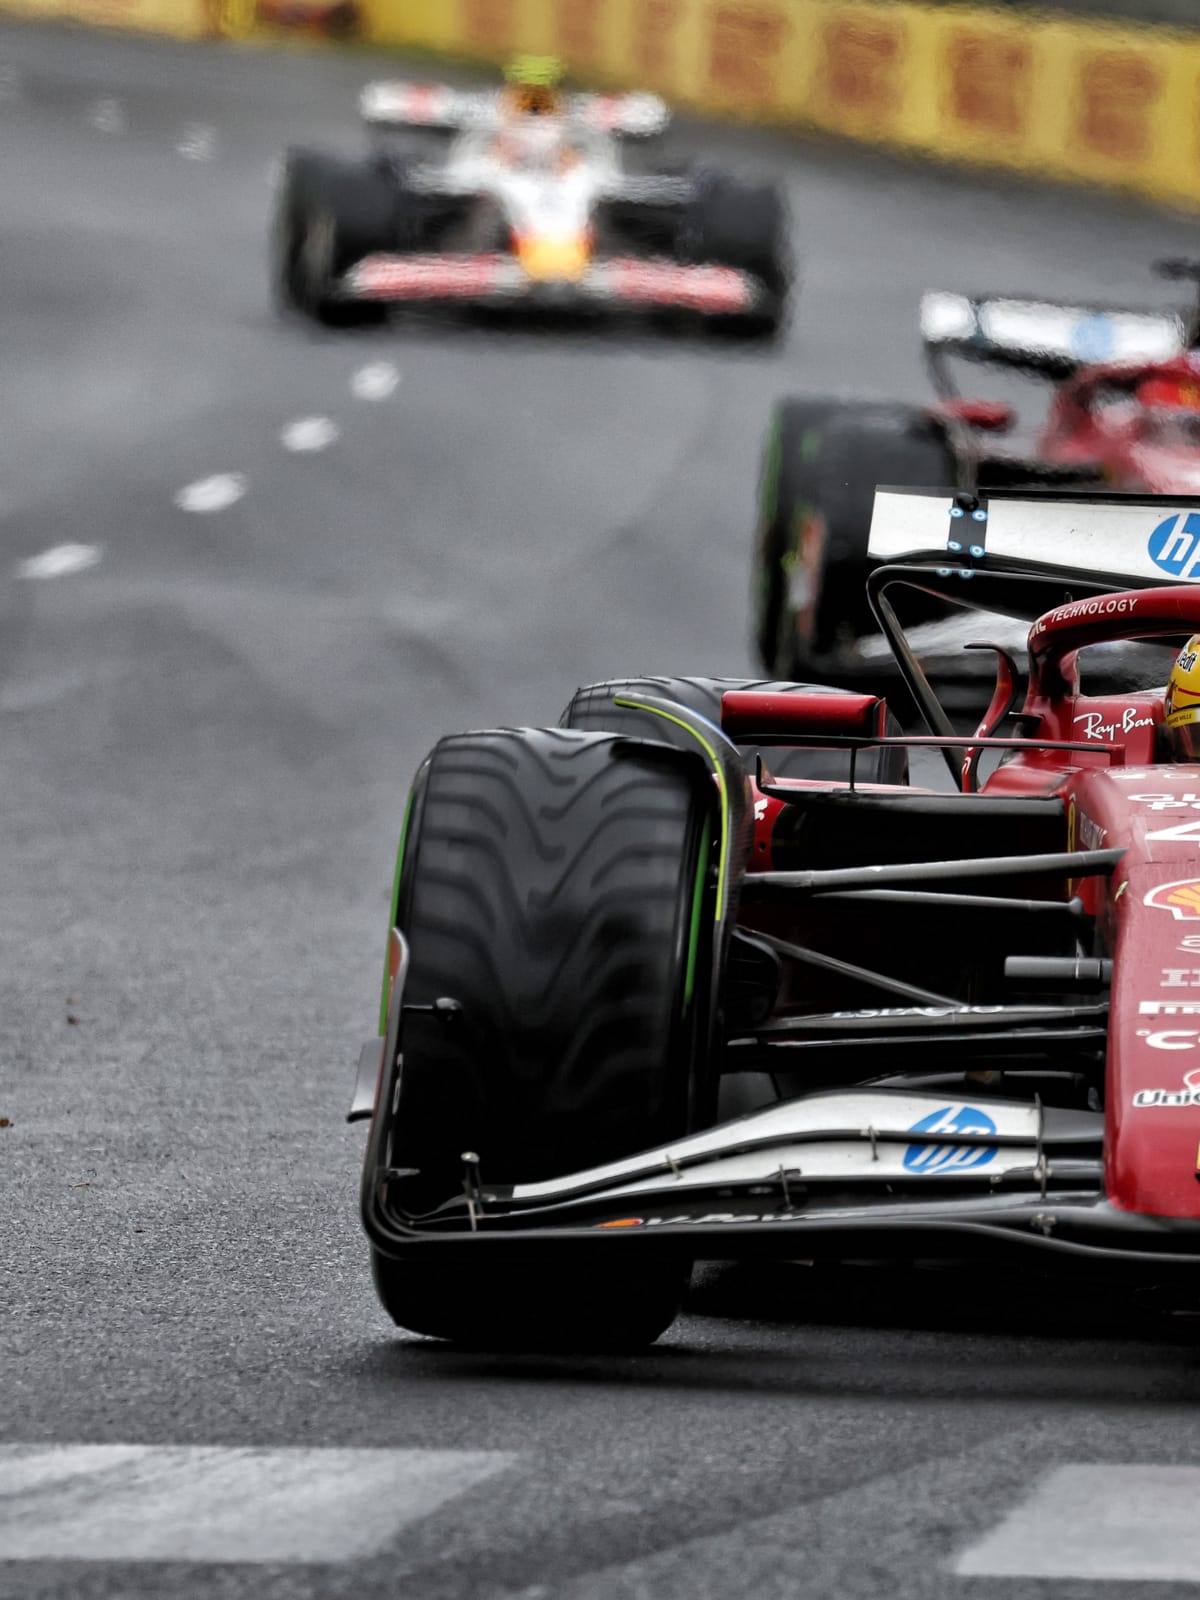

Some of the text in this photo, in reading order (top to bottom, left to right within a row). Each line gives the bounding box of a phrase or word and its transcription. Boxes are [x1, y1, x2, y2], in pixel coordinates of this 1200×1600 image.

[1051, 598, 1138, 624] TECHNOLOGY
[1073, 708, 1154, 741] Ray-Ban
[908, 1106, 993, 1175] hp
